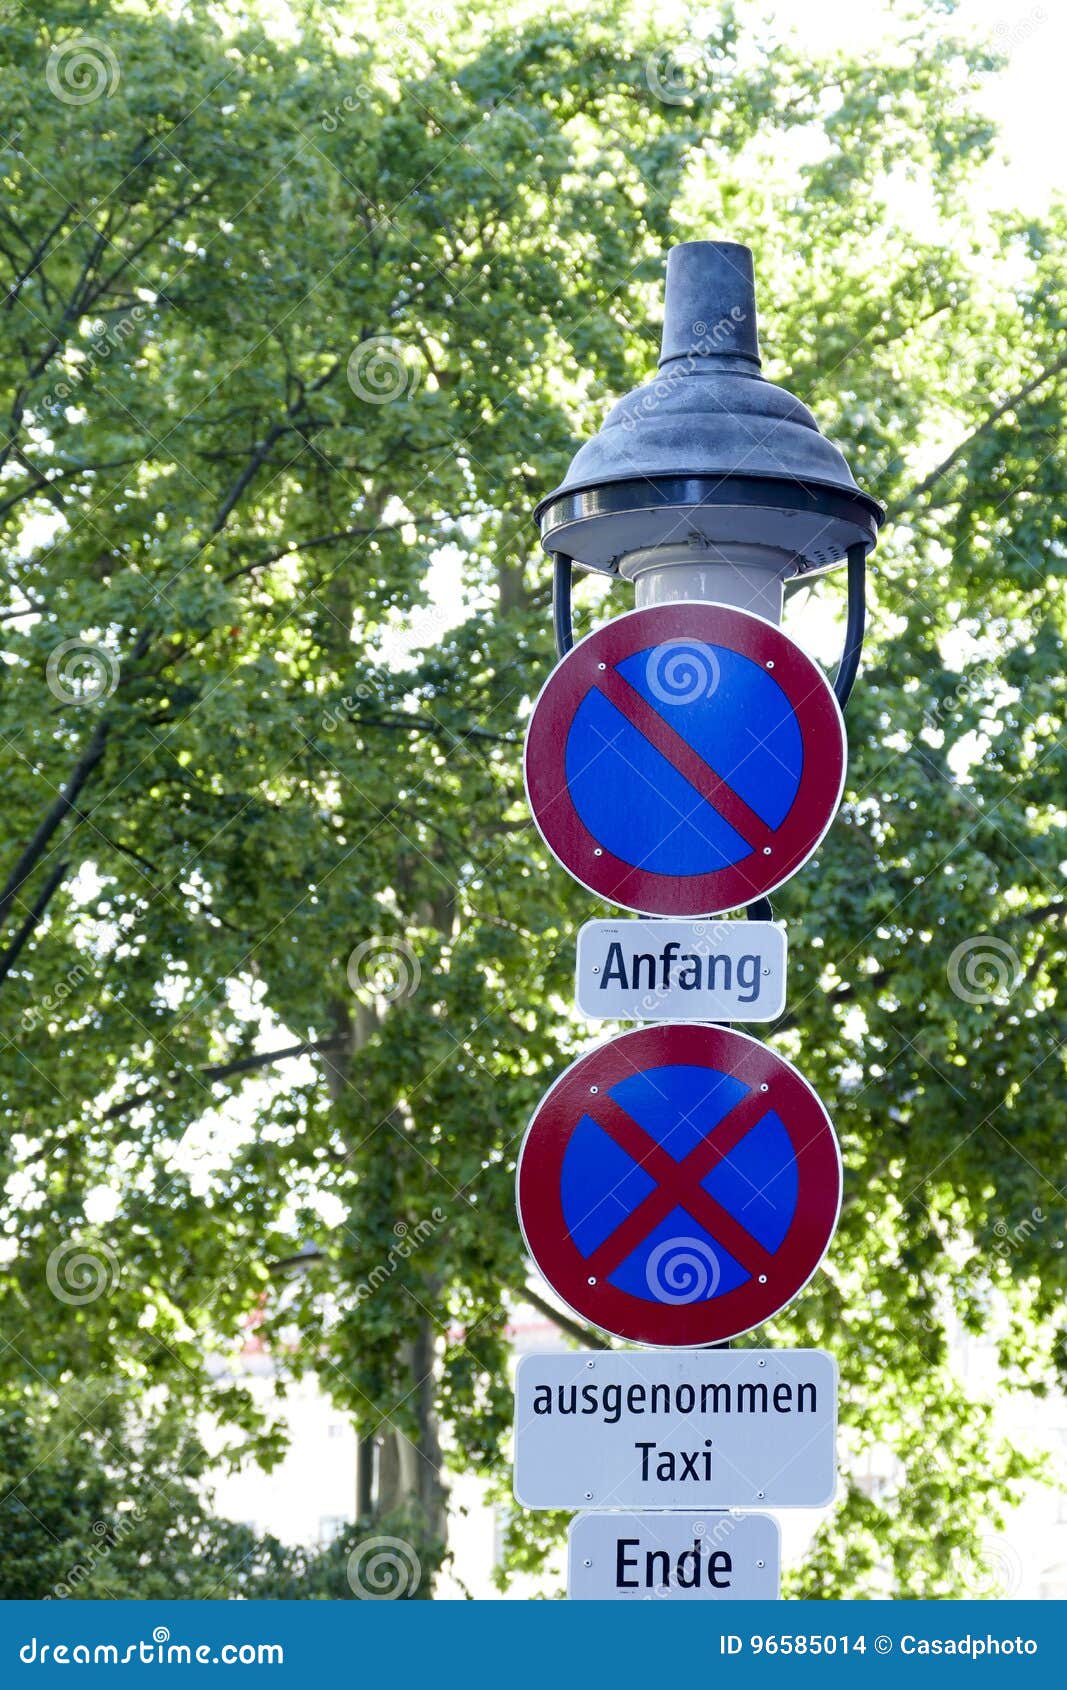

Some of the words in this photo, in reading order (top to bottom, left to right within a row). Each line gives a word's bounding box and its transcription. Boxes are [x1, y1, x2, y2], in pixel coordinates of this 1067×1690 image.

[600, 942, 761, 1003] Anfang
[533, 1383, 817, 1424] ausgenommen
[634, 1439, 713, 1482] Taxi
[616, 1538, 732, 1589] Ende
